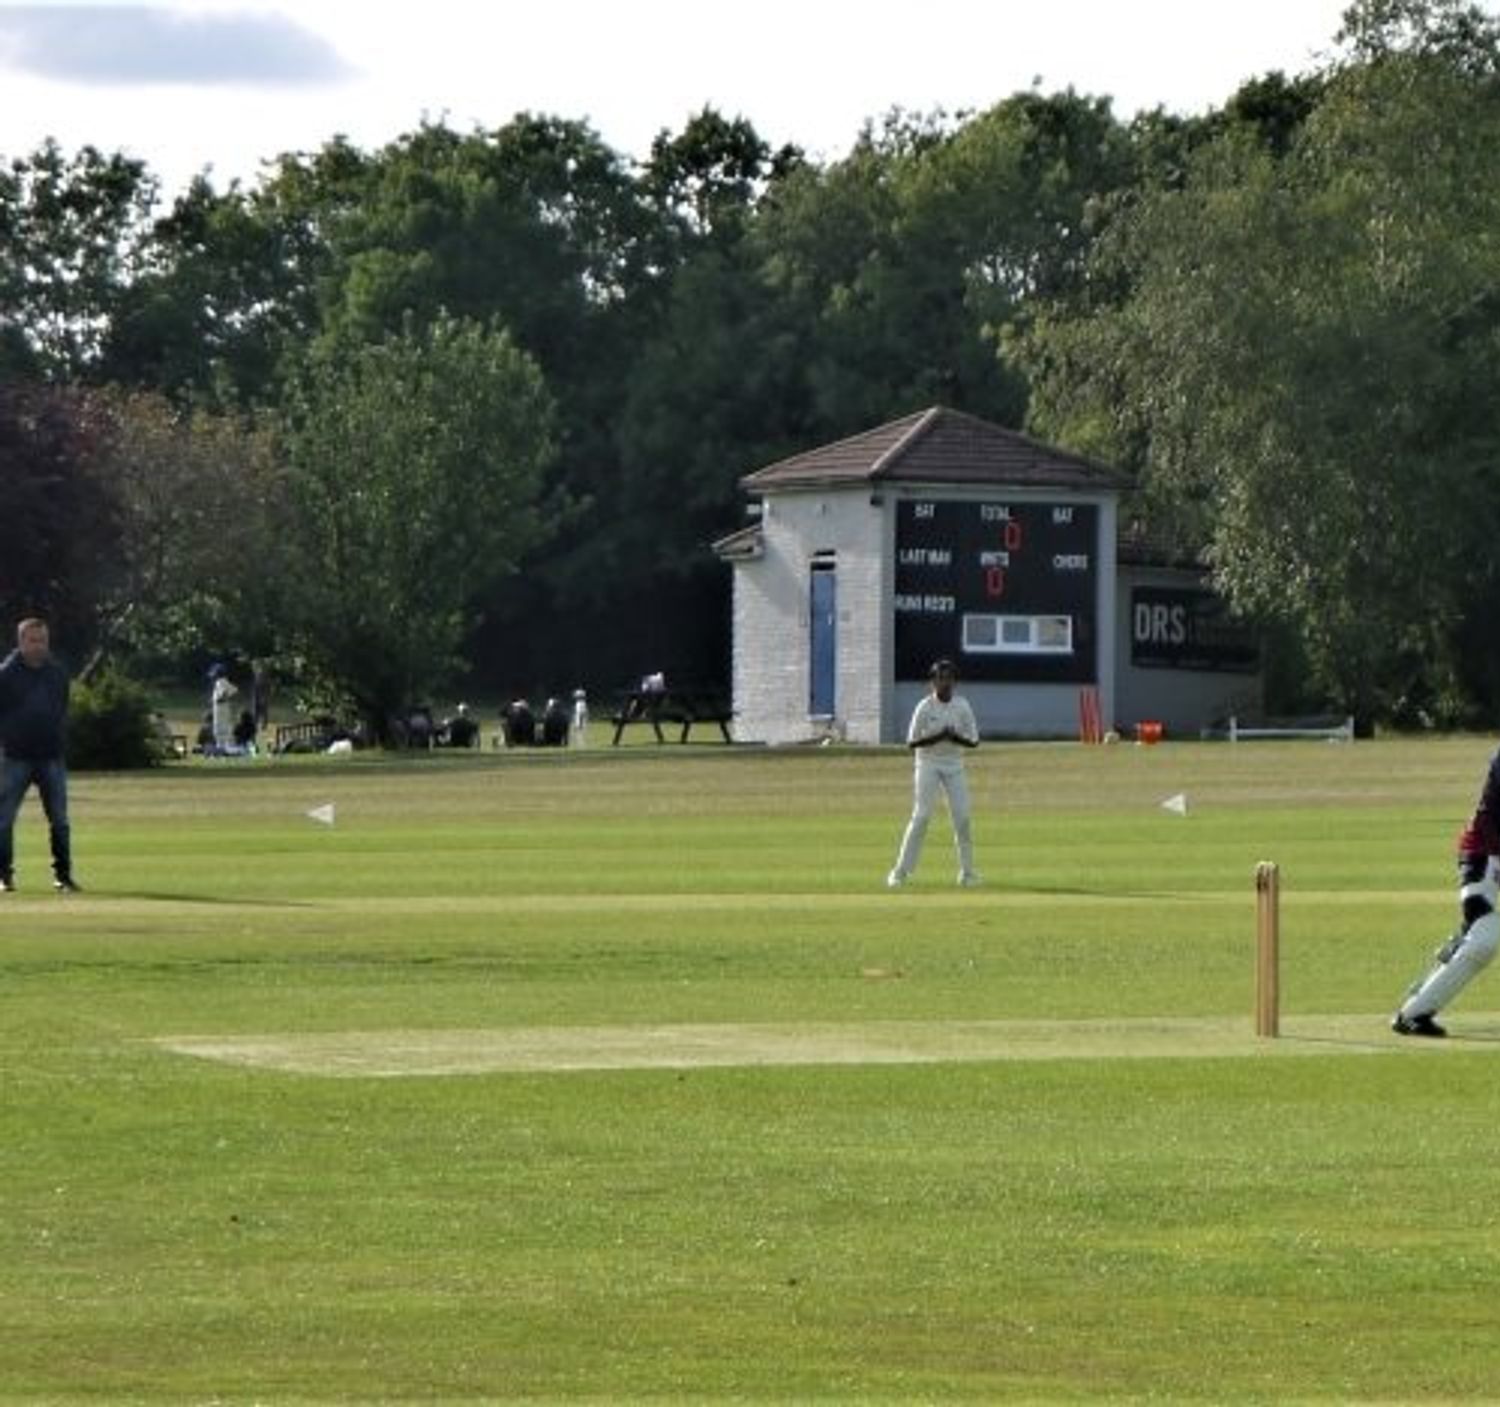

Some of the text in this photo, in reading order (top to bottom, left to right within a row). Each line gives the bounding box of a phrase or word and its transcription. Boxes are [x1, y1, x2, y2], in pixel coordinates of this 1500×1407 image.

[981, 504, 1014, 521] TOTAL
[1053, 508, 1073, 524] BAT
[1005, 522, 1020, 550] 0
[987, 567, 1004, 595] 0
[1134, 602, 1186, 645] DRS
